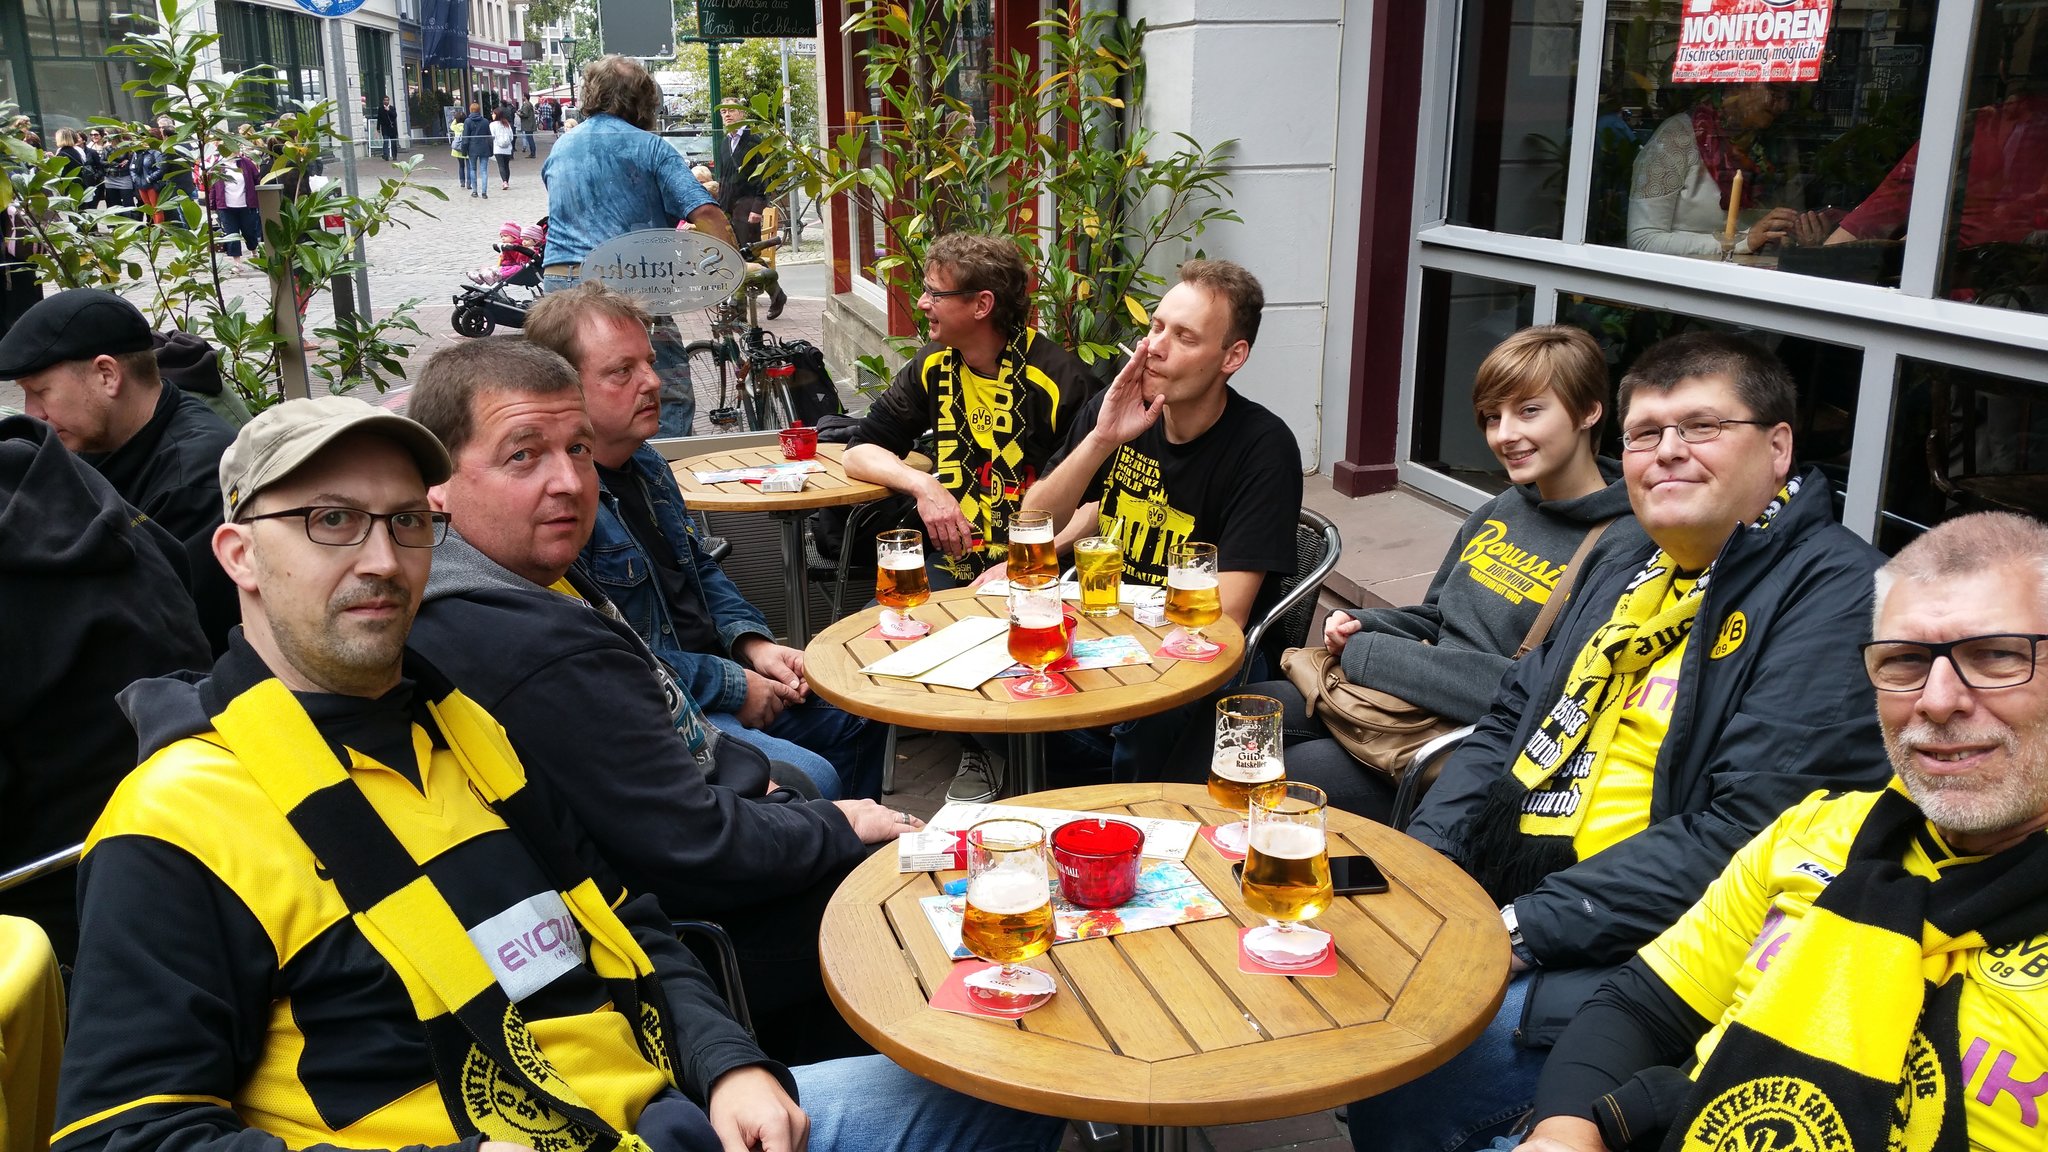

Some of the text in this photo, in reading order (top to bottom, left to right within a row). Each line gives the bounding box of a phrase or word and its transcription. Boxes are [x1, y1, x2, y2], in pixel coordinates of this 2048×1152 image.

[1682, 8, 1829, 44] MONITOREN
[798, 41, 816, 52] Burgs
[1680, 42, 1821, 65] Tischreservierung möglich!
[971, 408, 991, 426] BVB
[1117, 462, 1159, 489] SCHWARZ
[1120, 452, 1161, 479] BERLIN
[1114, 470, 1144, 492] GELB
[1148, 507, 1164, 522] BVB
[1460, 519, 1568, 590] Borussi
[1487, 563, 1535, 592] DORTMUND
[1715, 643, 1727, 656] 09
[1236, 760, 1267, 769] Ratskeller
[1237, 750, 1266, 761] Gilde
[1989, 960, 2015, 979] 09
[1799, 1092, 1850, 1152] FANC
